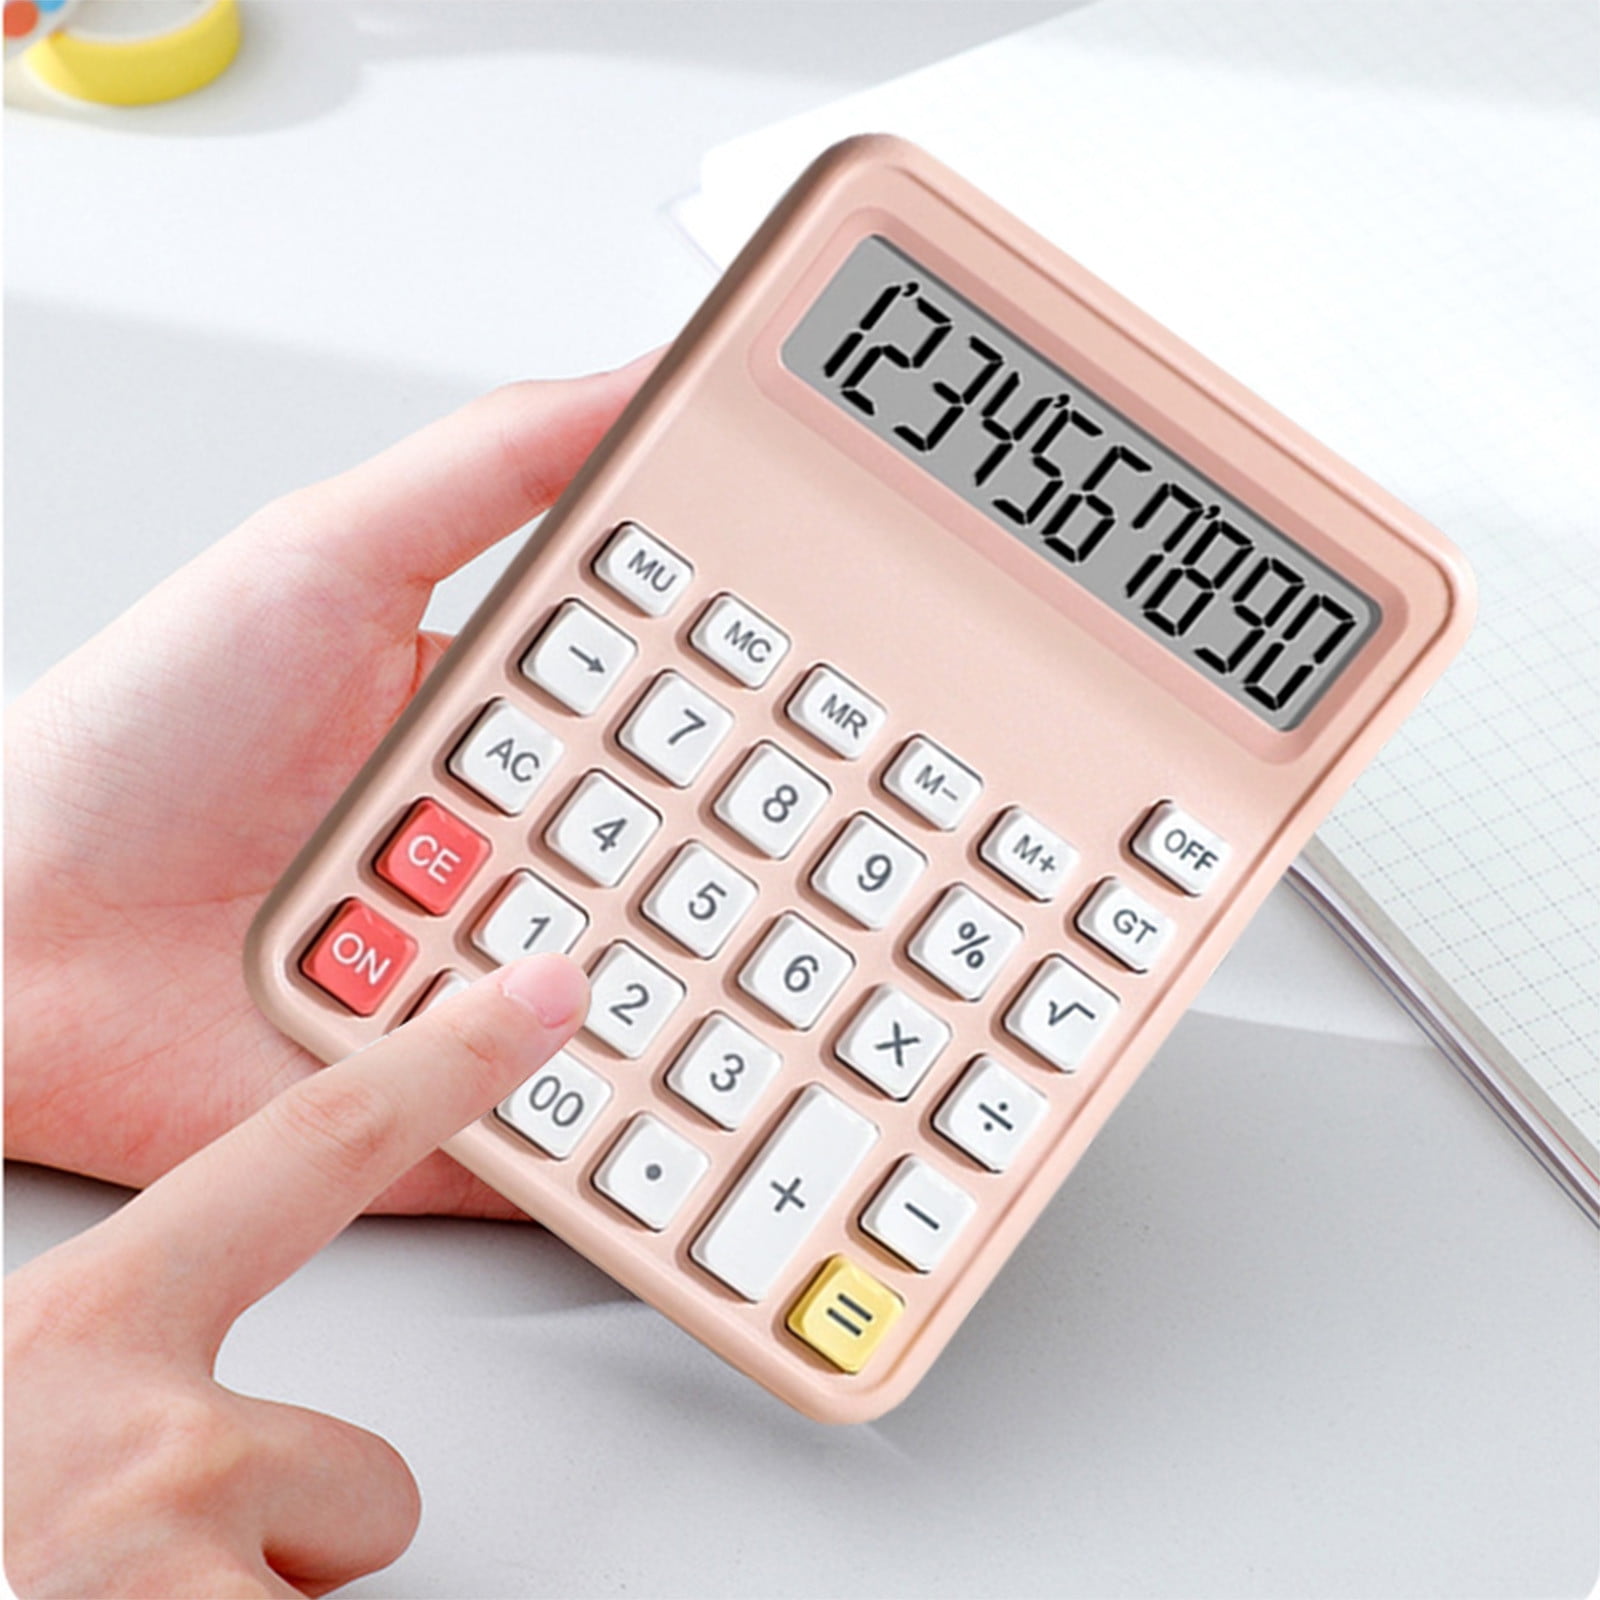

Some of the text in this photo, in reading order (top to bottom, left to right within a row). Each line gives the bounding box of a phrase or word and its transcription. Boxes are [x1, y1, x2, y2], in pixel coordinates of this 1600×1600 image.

[627, 549, 677, 593] MU
[724, 620, 772, 664] MC
[668, 709, 706, 745] 7
[820, 693, 868, 739] MR
[486, 738, 540, 783] AC
[763, 784, 798, 823] 8
[593, 818, 627, 852] 4
[1163, 829, 1218, 873] OFF
[408, 835, 460, 883] CE
[858, 854, 892, 892] 9
[688, 882, 727, 920] 5
[523, 917, 550, 950] 1
[952, 922, 990, 969] %
[1112, 909, 1157, 946] GT
[332, 932, 390, 985] ON
[784, 955, 819, 992] 6
[610, 983, 649, 1026] 2
[710, 1053, 744, 1092] 3
[529, 1075, 585, 1127] 00
